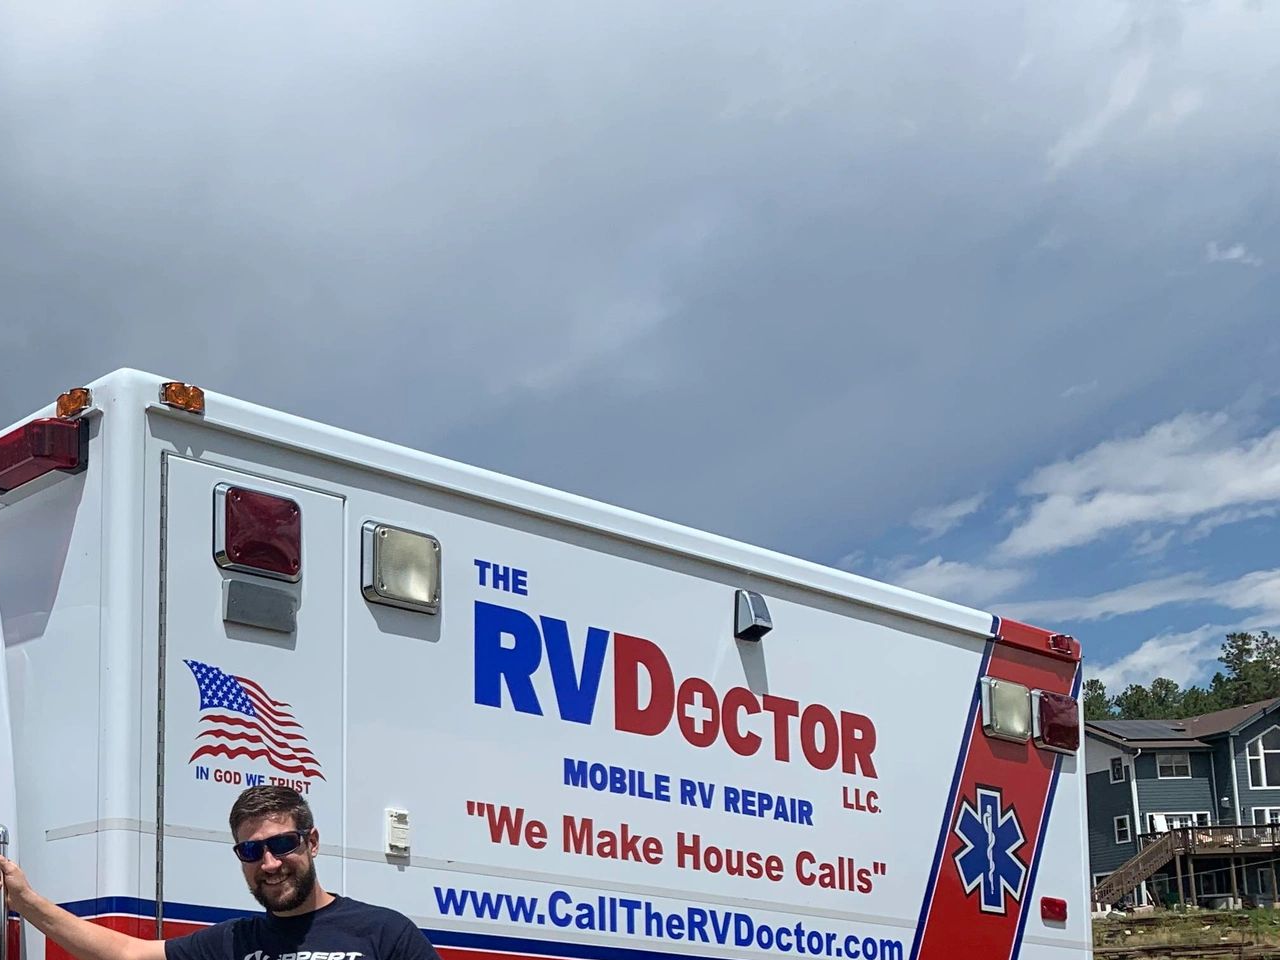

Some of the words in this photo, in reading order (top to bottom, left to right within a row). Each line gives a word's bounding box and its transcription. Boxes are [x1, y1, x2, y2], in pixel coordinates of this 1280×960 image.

[473, 558, 529, 596] THE
[195, 765, 209, 780] IN
[214, 769, 241, 784] GOD
[563, 757, 671, 802] MOBILE
[680, 778, 715, 810] RV
[723, 786, 814, 826] REPAIR
[842, 786, 882, 813] LLC.
[466, 800, 548, 849] "We
[562, 815, 664, 865] Make
[676, 832, 784, 881] House
[795, 850, 888, 895] Calls"
